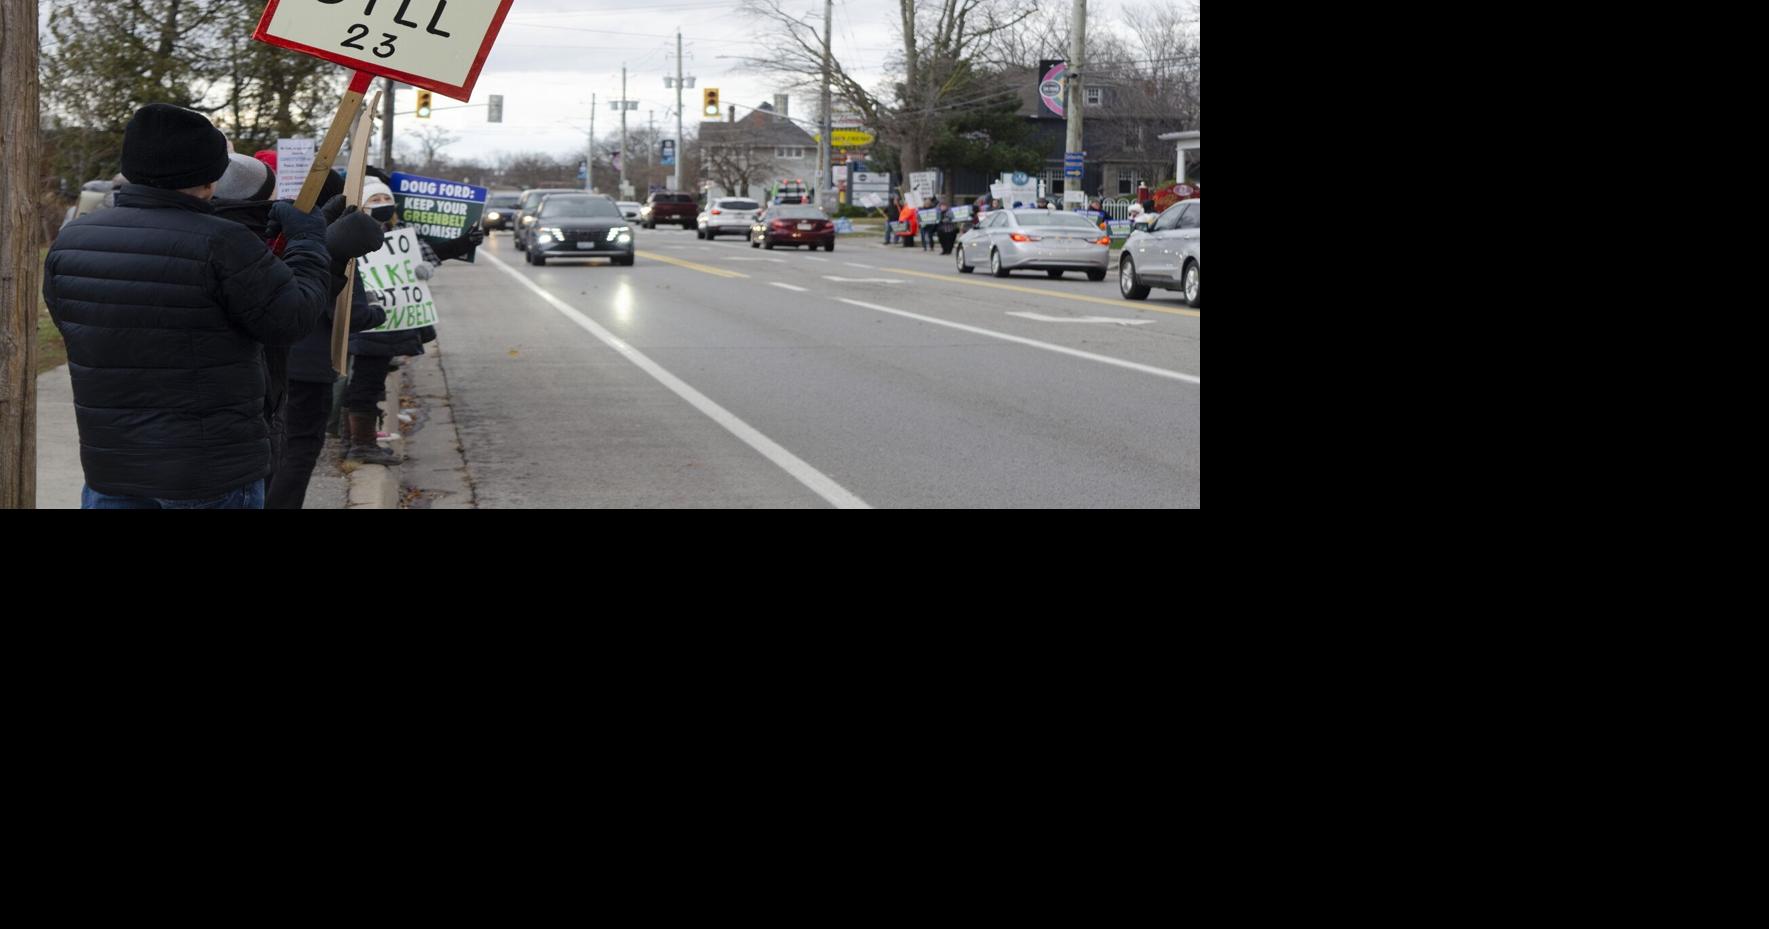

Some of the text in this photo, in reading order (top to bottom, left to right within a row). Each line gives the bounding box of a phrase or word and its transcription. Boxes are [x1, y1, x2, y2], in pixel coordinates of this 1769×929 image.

[316, 0, 450, 38] LL
[340, 23, 398, 58] 23
[400, 179, 475, 199] DOUG FORD:
[404, 197, 468, 215] KEEP YOUR
[403, 210, 467, 227] GREENBELT
[383, 234, 410, 255] TO
[360, 259, 416, 289] RIKE
[402, 286, 422, 303] TO
[375, 302, 436, 330] NBELT
